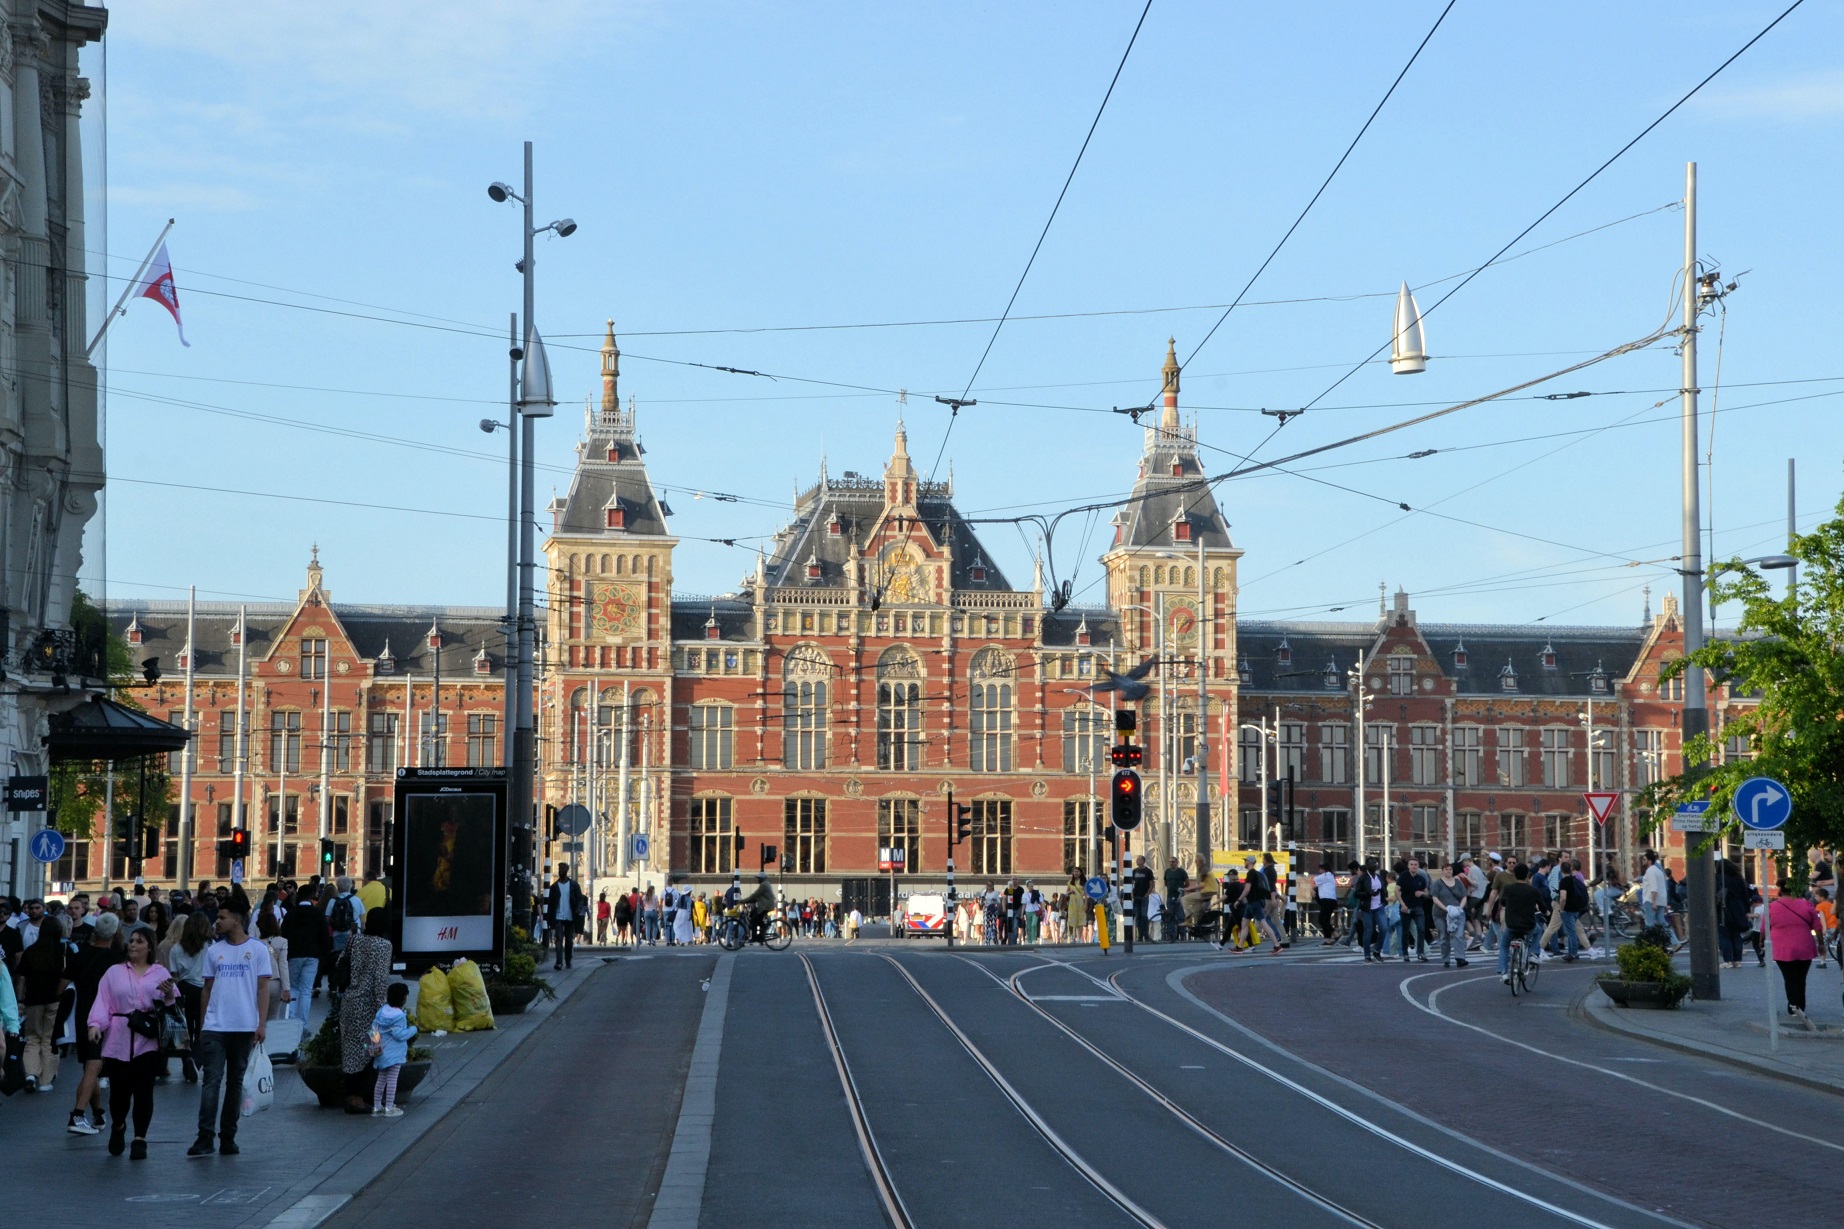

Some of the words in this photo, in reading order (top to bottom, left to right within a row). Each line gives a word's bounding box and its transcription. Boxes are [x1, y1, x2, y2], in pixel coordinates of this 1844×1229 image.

[417, 769, 473, 777] Stadsplattegrond
[478, 769, 491, 777] City
[491, 769, 506, 777] map
[13, 789, 40, 800] snipes
[217, 963, 250, 971] Emirates
